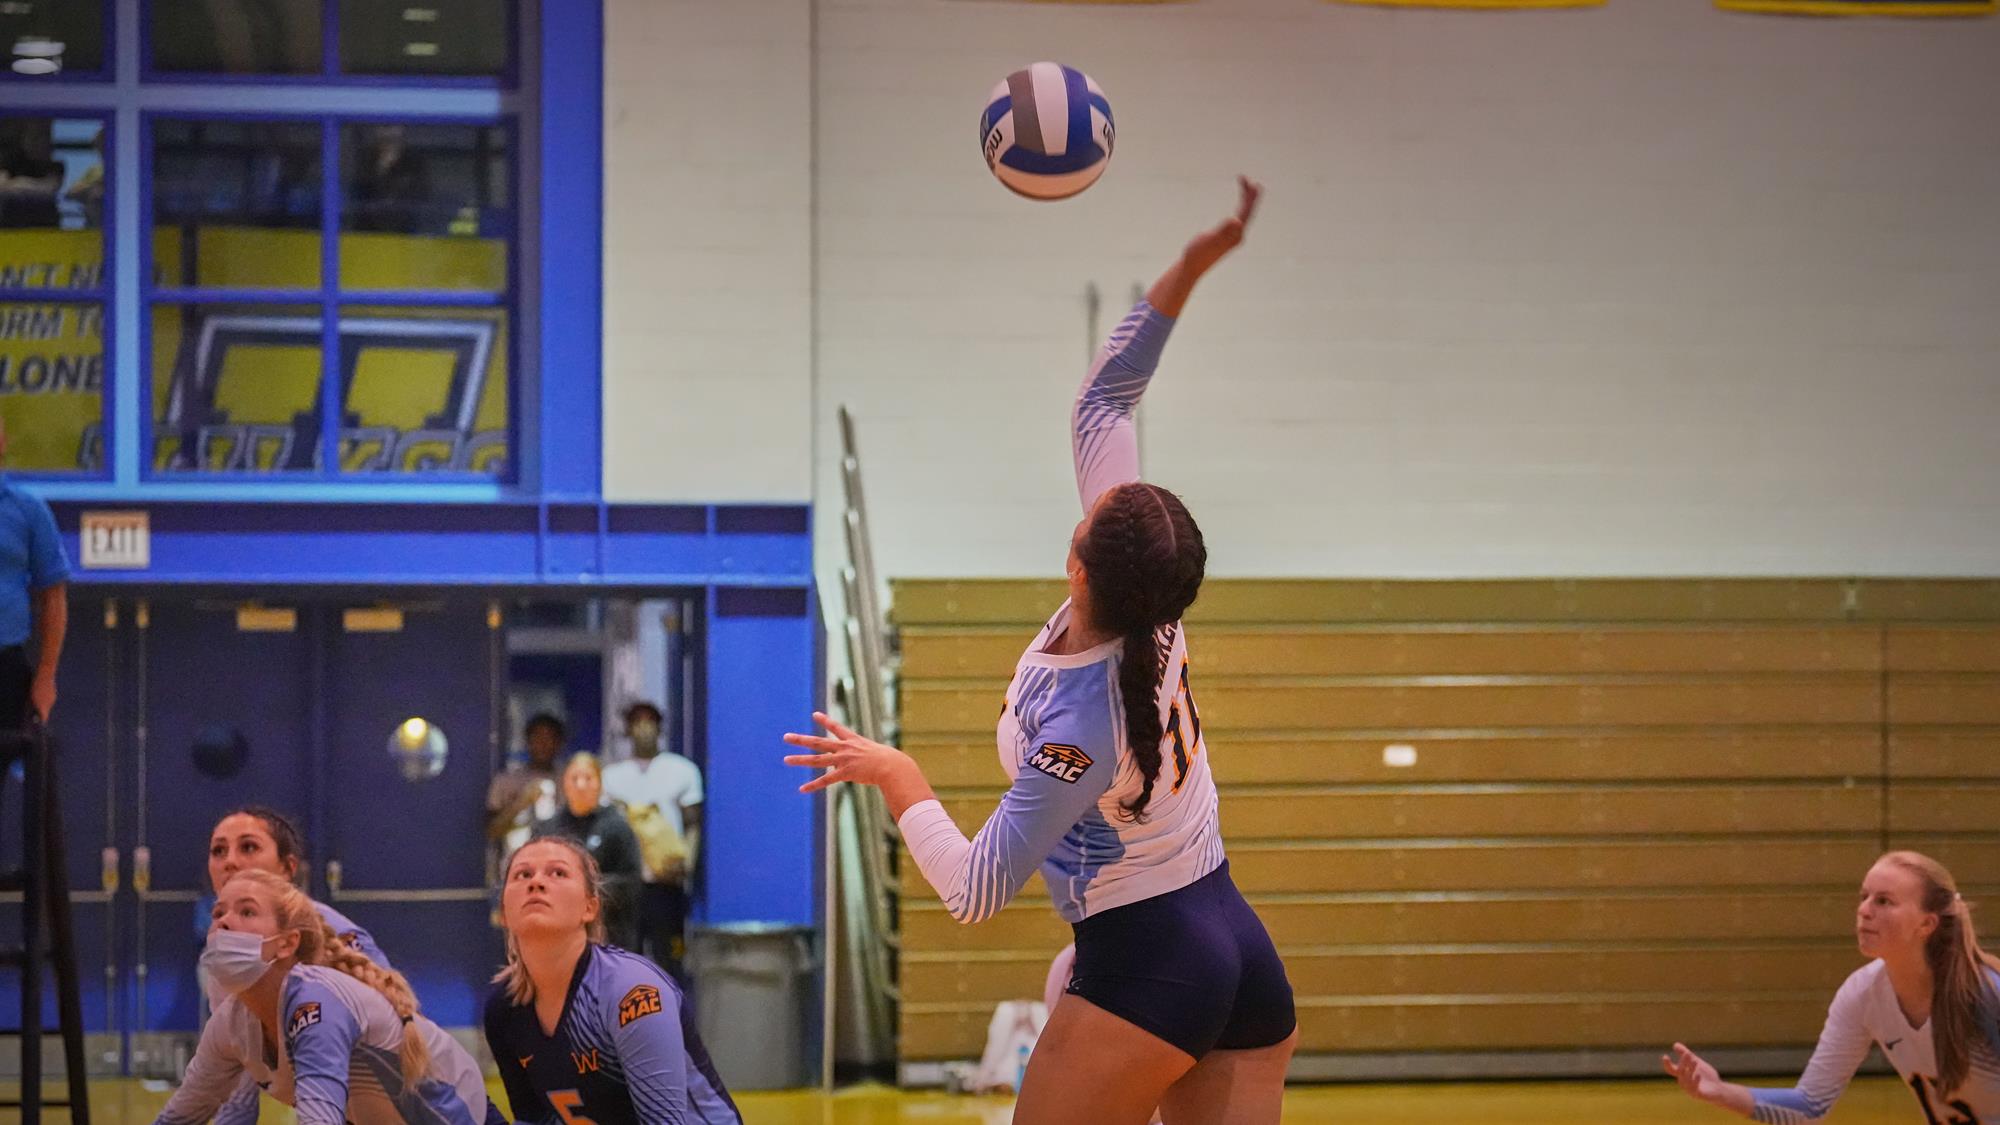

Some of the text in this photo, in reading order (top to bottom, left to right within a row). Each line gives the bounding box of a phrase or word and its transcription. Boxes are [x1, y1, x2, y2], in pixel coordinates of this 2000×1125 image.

[91, 518, 141, 556] EXIT
[1031, 752, 1084, 782] MAC
[621, 997, 661, 1026] MAC
